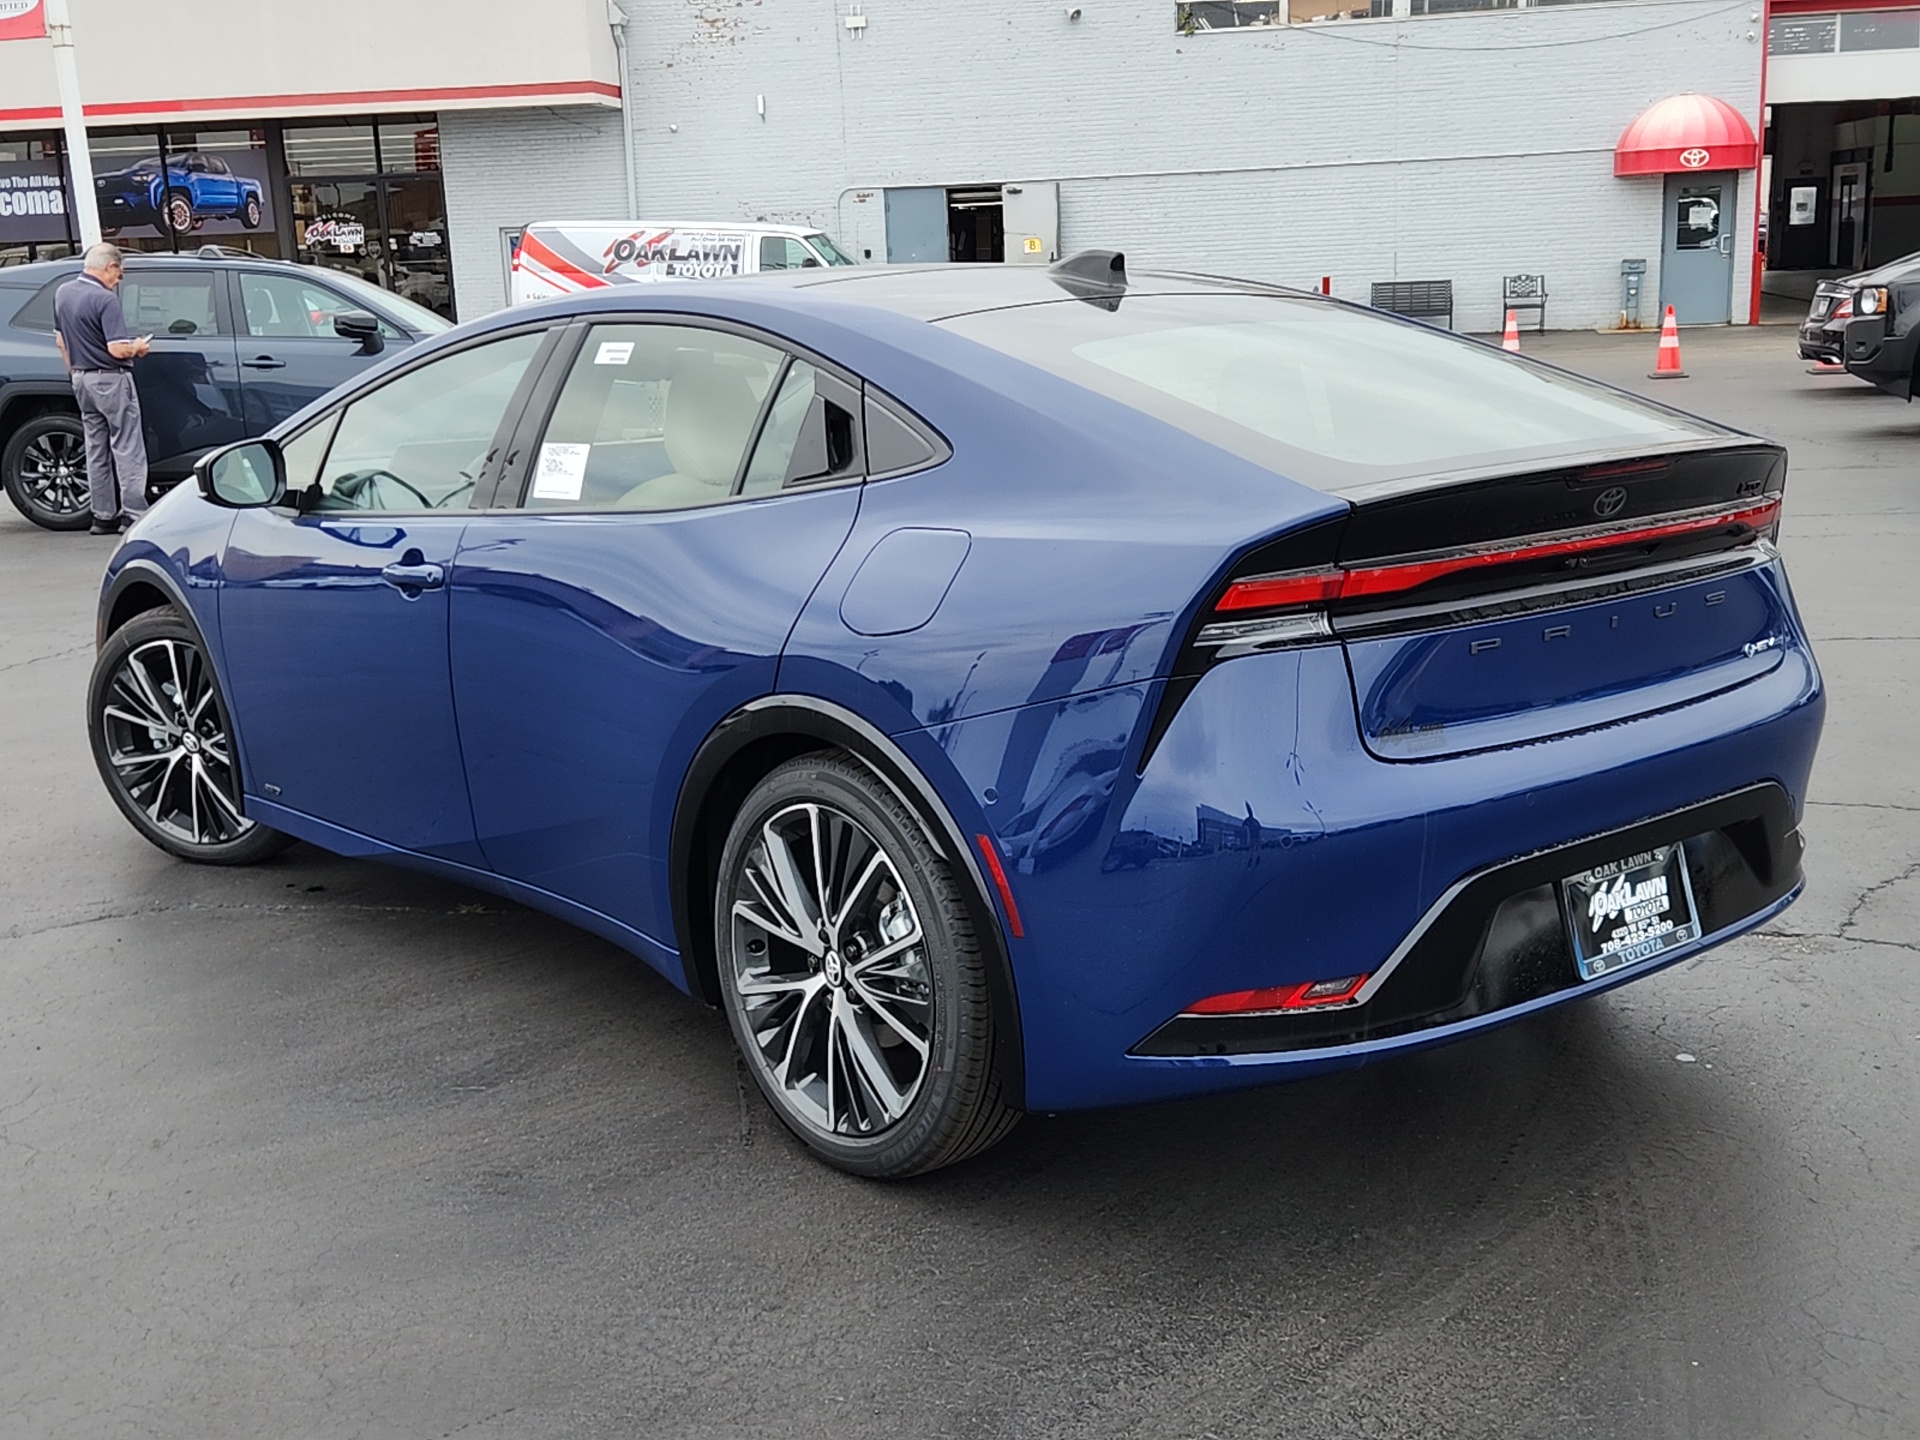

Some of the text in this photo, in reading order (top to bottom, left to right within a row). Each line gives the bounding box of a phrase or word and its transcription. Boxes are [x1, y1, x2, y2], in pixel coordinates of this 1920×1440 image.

[11, 176, 28, 188] The
[29, 175, 41, 188] All
[0, 190, 69, 217] coma
[1029, 240, 1037, 251] 8
[672, 264, 734, 278] TOYOTA
[1470, 590, 1727, 656] PRIUS
[1594, 851, 1652, 877] OAK LAWN
[1629, 899, 1664, 917] TOYOTA
[1600, 919, 1674, 954] 708-423-5200
[1617, 937, 1665, 963] TOYOTA
